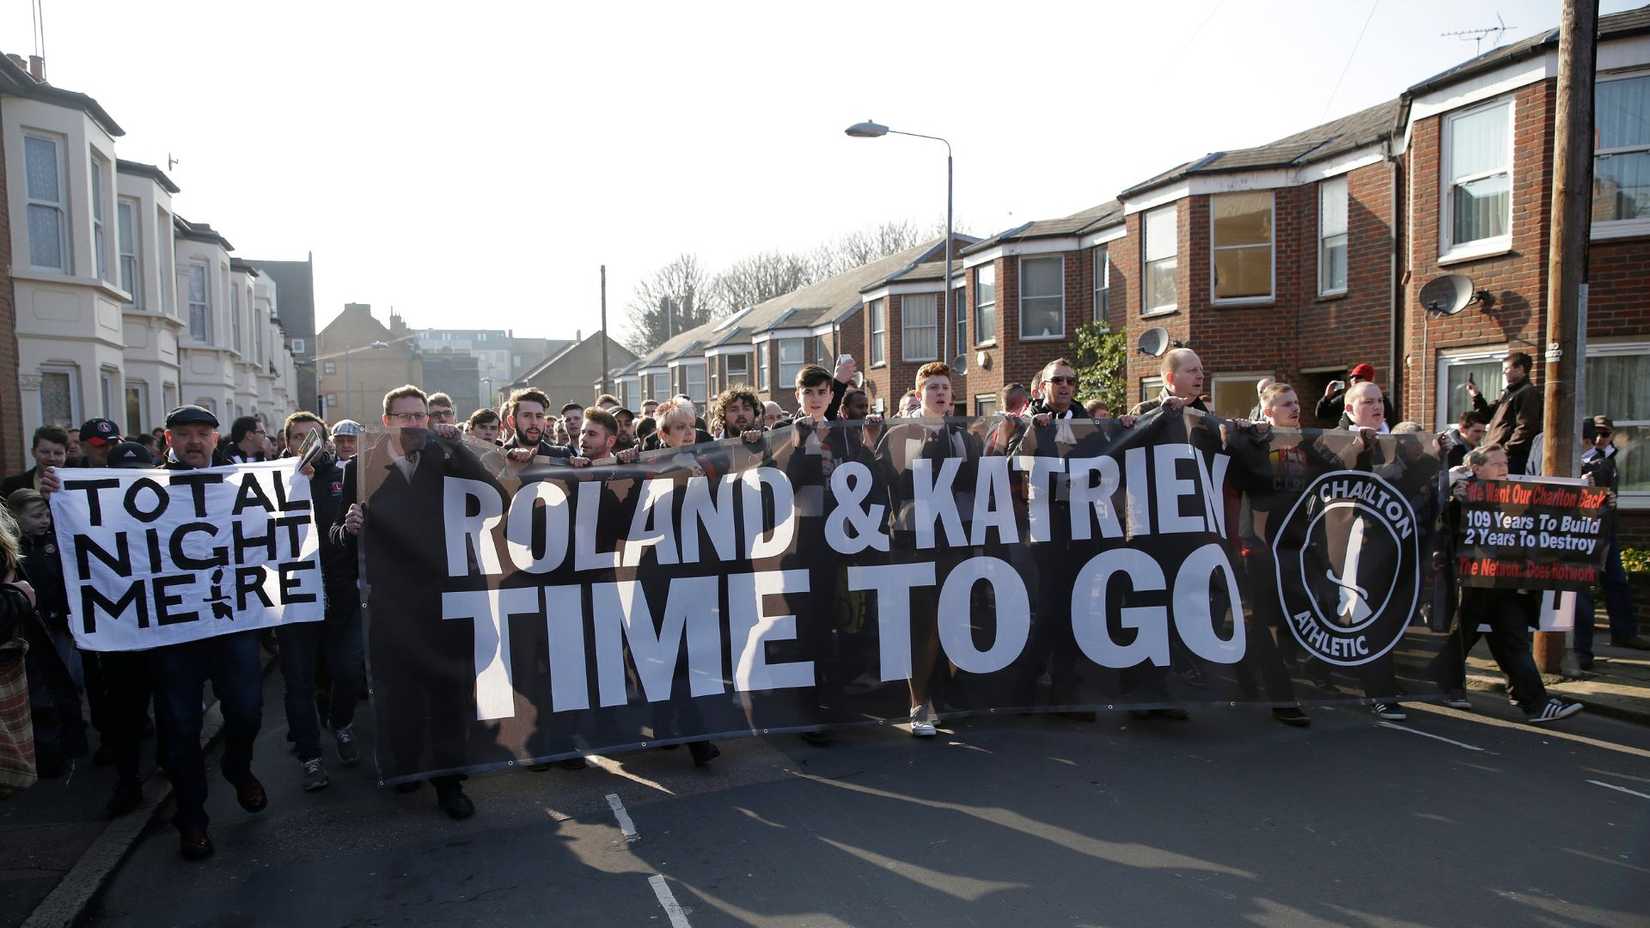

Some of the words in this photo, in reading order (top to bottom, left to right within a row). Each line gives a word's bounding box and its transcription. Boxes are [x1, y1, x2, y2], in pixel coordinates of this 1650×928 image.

[64, 470, 311, 526] TOTAL
[443, 466, 796, 577] ROLAND
[824, 461, 889, 554] &
[912, 443, 1230, 549] KATRIEN
[1319, 480, 1413, 540] CHARLTON
[1467, 510, 1491, 527] 109
[1494, 512, 1534, 530] Years
[1539, 514, 1558, 531] To
[1560, 515, 1601, 534] Build
[1513, 483, 1531, 503] Our
[1533, 484, 1576, 508] Charlton
[1578, 488, 1606, 509] Back
[74, 515, 312, 580] NIGHT
[1464, 529, 1476, 545] 2
[1480, 529, 1516, 546] Years
[1520, 531, 1536, 547] To
[1540, 533, 1597, 555] Destroy
[441, 569, 816, 721] TIME
[848, 556, 1031, 682] TO
[1071, 543, 1246, 668] GO
[1294, 610, 1369, 657] ATHLETIC
